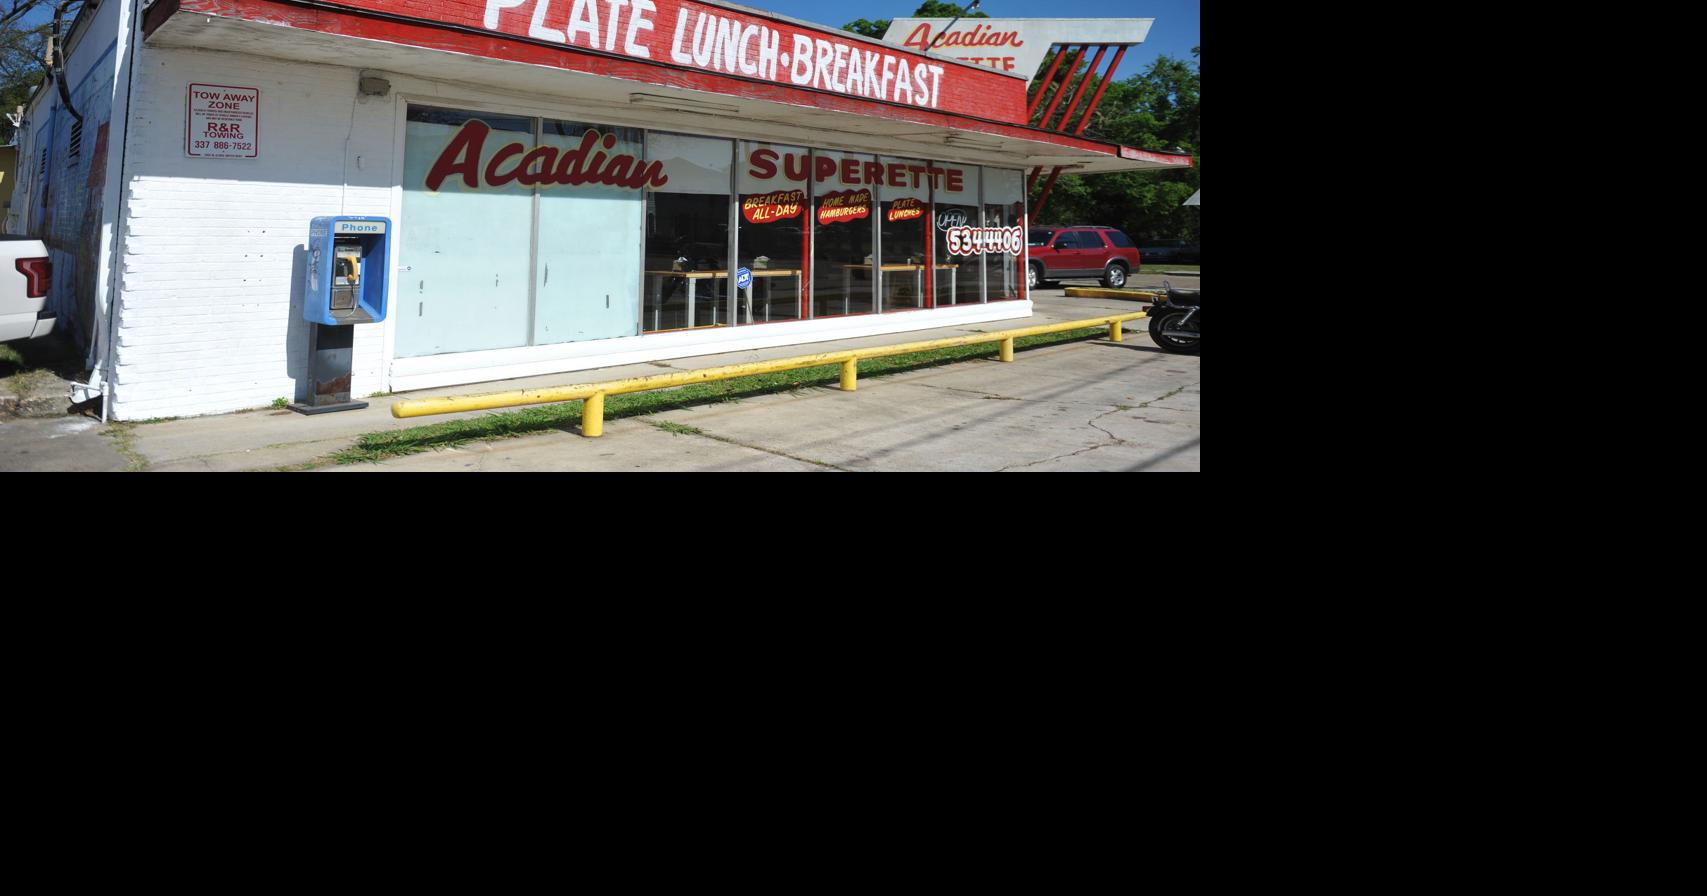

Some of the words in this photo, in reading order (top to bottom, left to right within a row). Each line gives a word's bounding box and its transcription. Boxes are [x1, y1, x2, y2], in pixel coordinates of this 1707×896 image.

[903, 22, 1024, 52] Acadian
[670, 8, 780, 81] LUNCH
[790, 33, 944, 108] BREAKFAST
[193, 91, 220, 100] TOW
[223, 93, 255, 103] AWAY
[208, 101, 240, 110] ZONE
[207, 122, 240, 132] R&R
[203, 131, 244, 139] TOWING
[195, 141, 209, 149] 337
[424, 118, 669, 195] Acadian
[749, 147, 964, 193] SUPERETTE
[744, 191, 803, 210] BREAKFAST
[823, 196, 845, 208] HOME
[848, 191, 869, 205] MADE
[892, 198, 915, 210] PLATE
[752, 202, 799, 221] ALL-DAY
[820, 206, 866, 220] HAMBURGERS
[889, 207, 921, 221] LUNCHES
[341, 223, 378, 232] Phone
